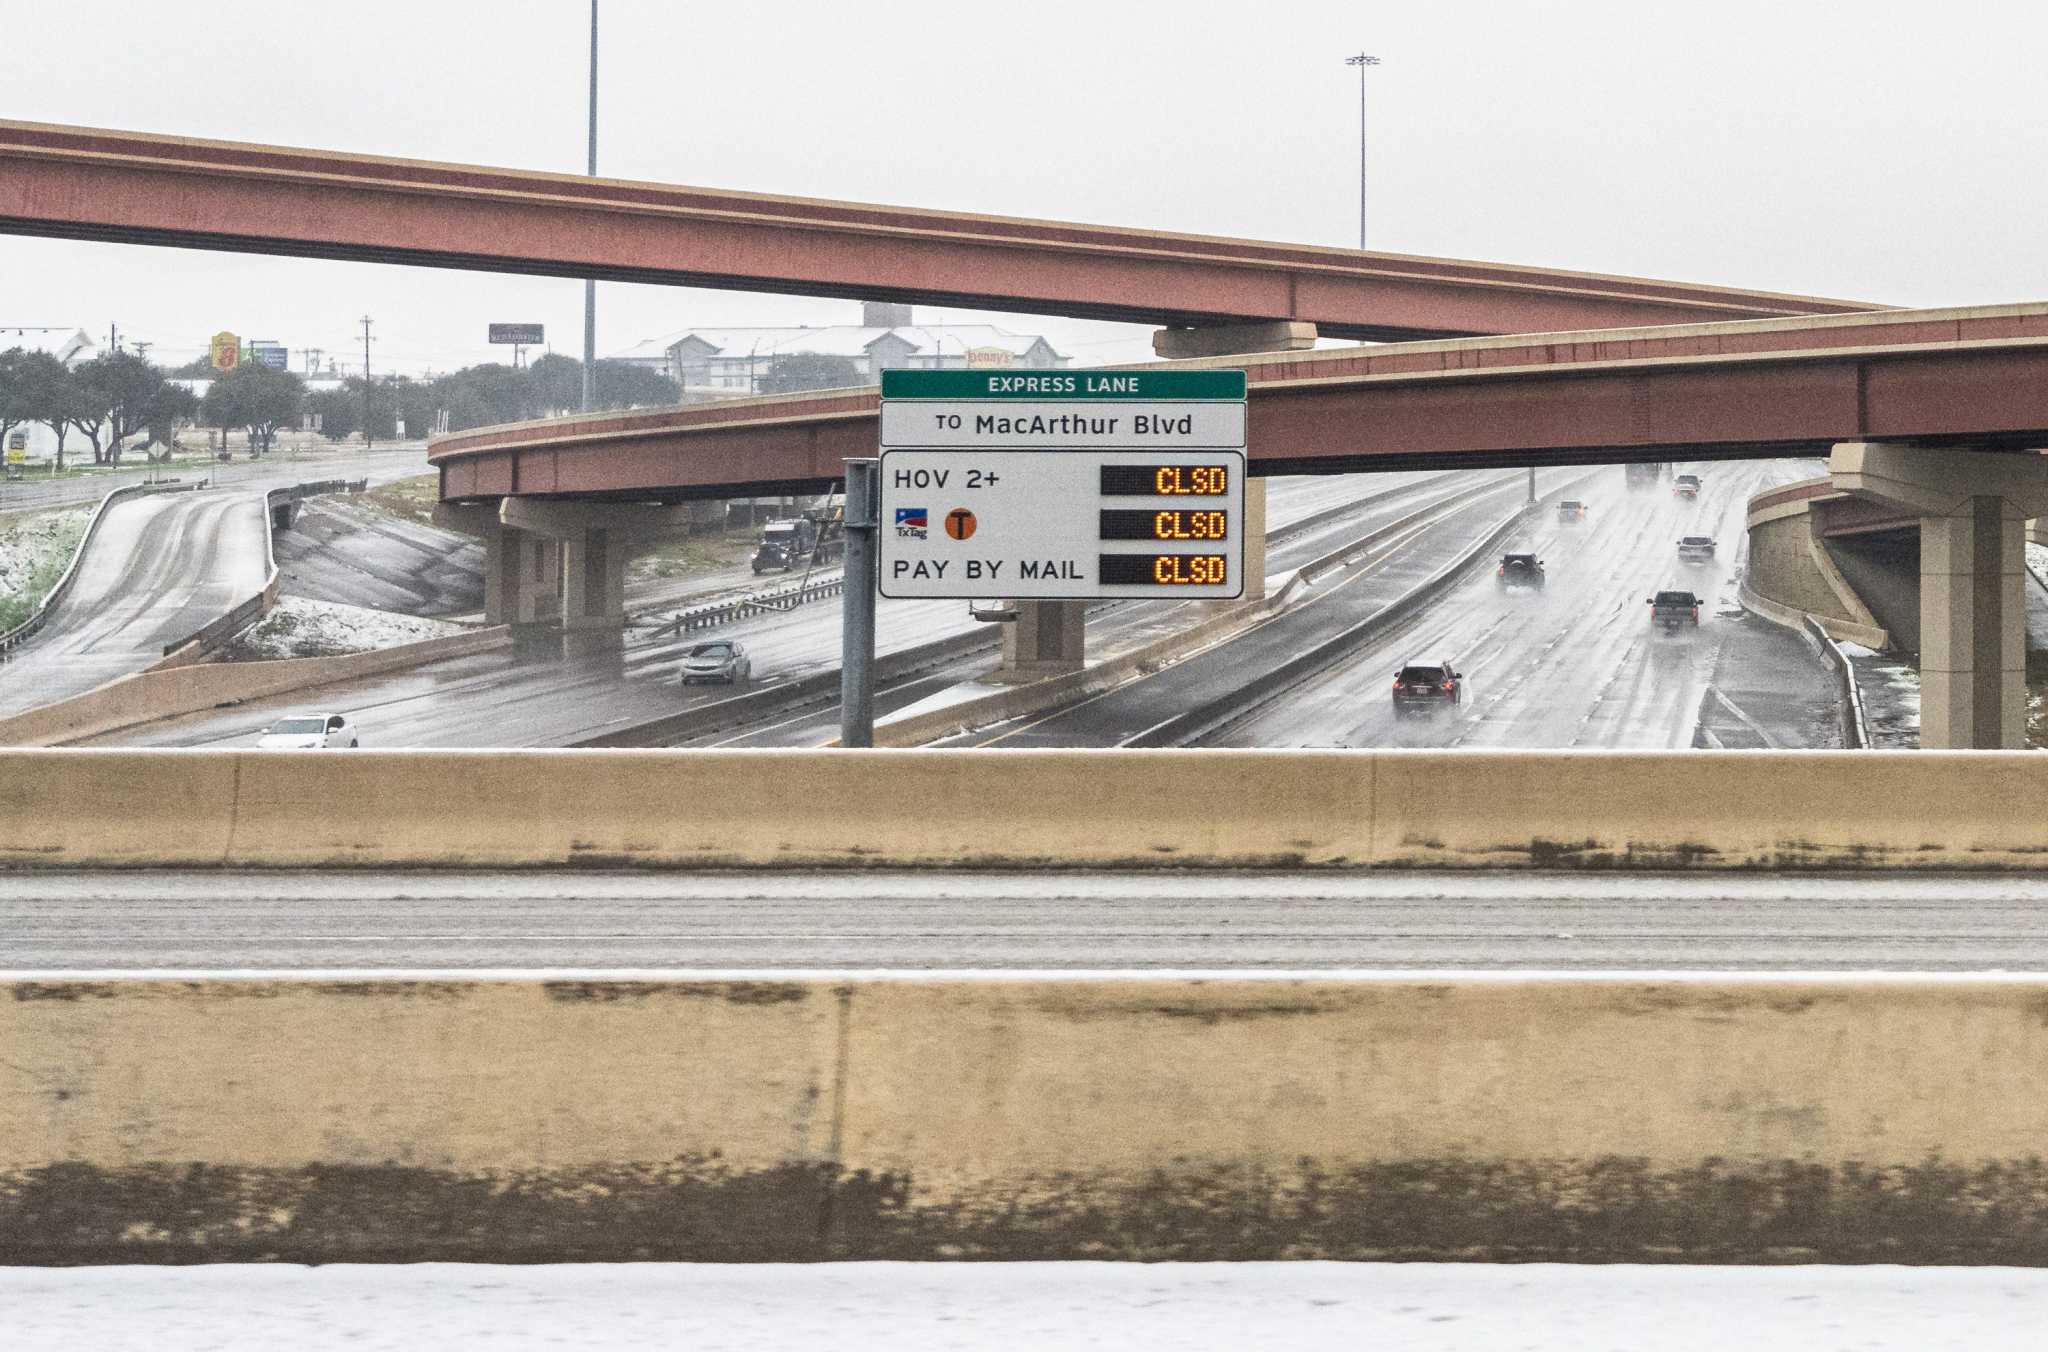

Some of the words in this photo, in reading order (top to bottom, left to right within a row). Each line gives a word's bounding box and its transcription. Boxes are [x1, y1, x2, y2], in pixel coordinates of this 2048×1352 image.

[989, 377, 1075, 392] EXPRESS
[1087, 377, 1139, 392] LANE
[936, 415, 961, 429] TO
[976, 414, 1118, 434] MacArthur
[1135, 414, 1192, 434] Blvd
[895, 470, 949, 488] HOV
[967, 470, 999, 488] 2+
[1156, 468, 1226, 493] CLSD
[897, 526, 927, 539] TxTag
[1155, 512, 1225, 538] CLSD
[894, 560, 949, 579] PAY
[967, 561, 1003, 579] BY
[1020, 561, 1084, 579] MAIL
[1155, 557, 1225, 583] CLSD
